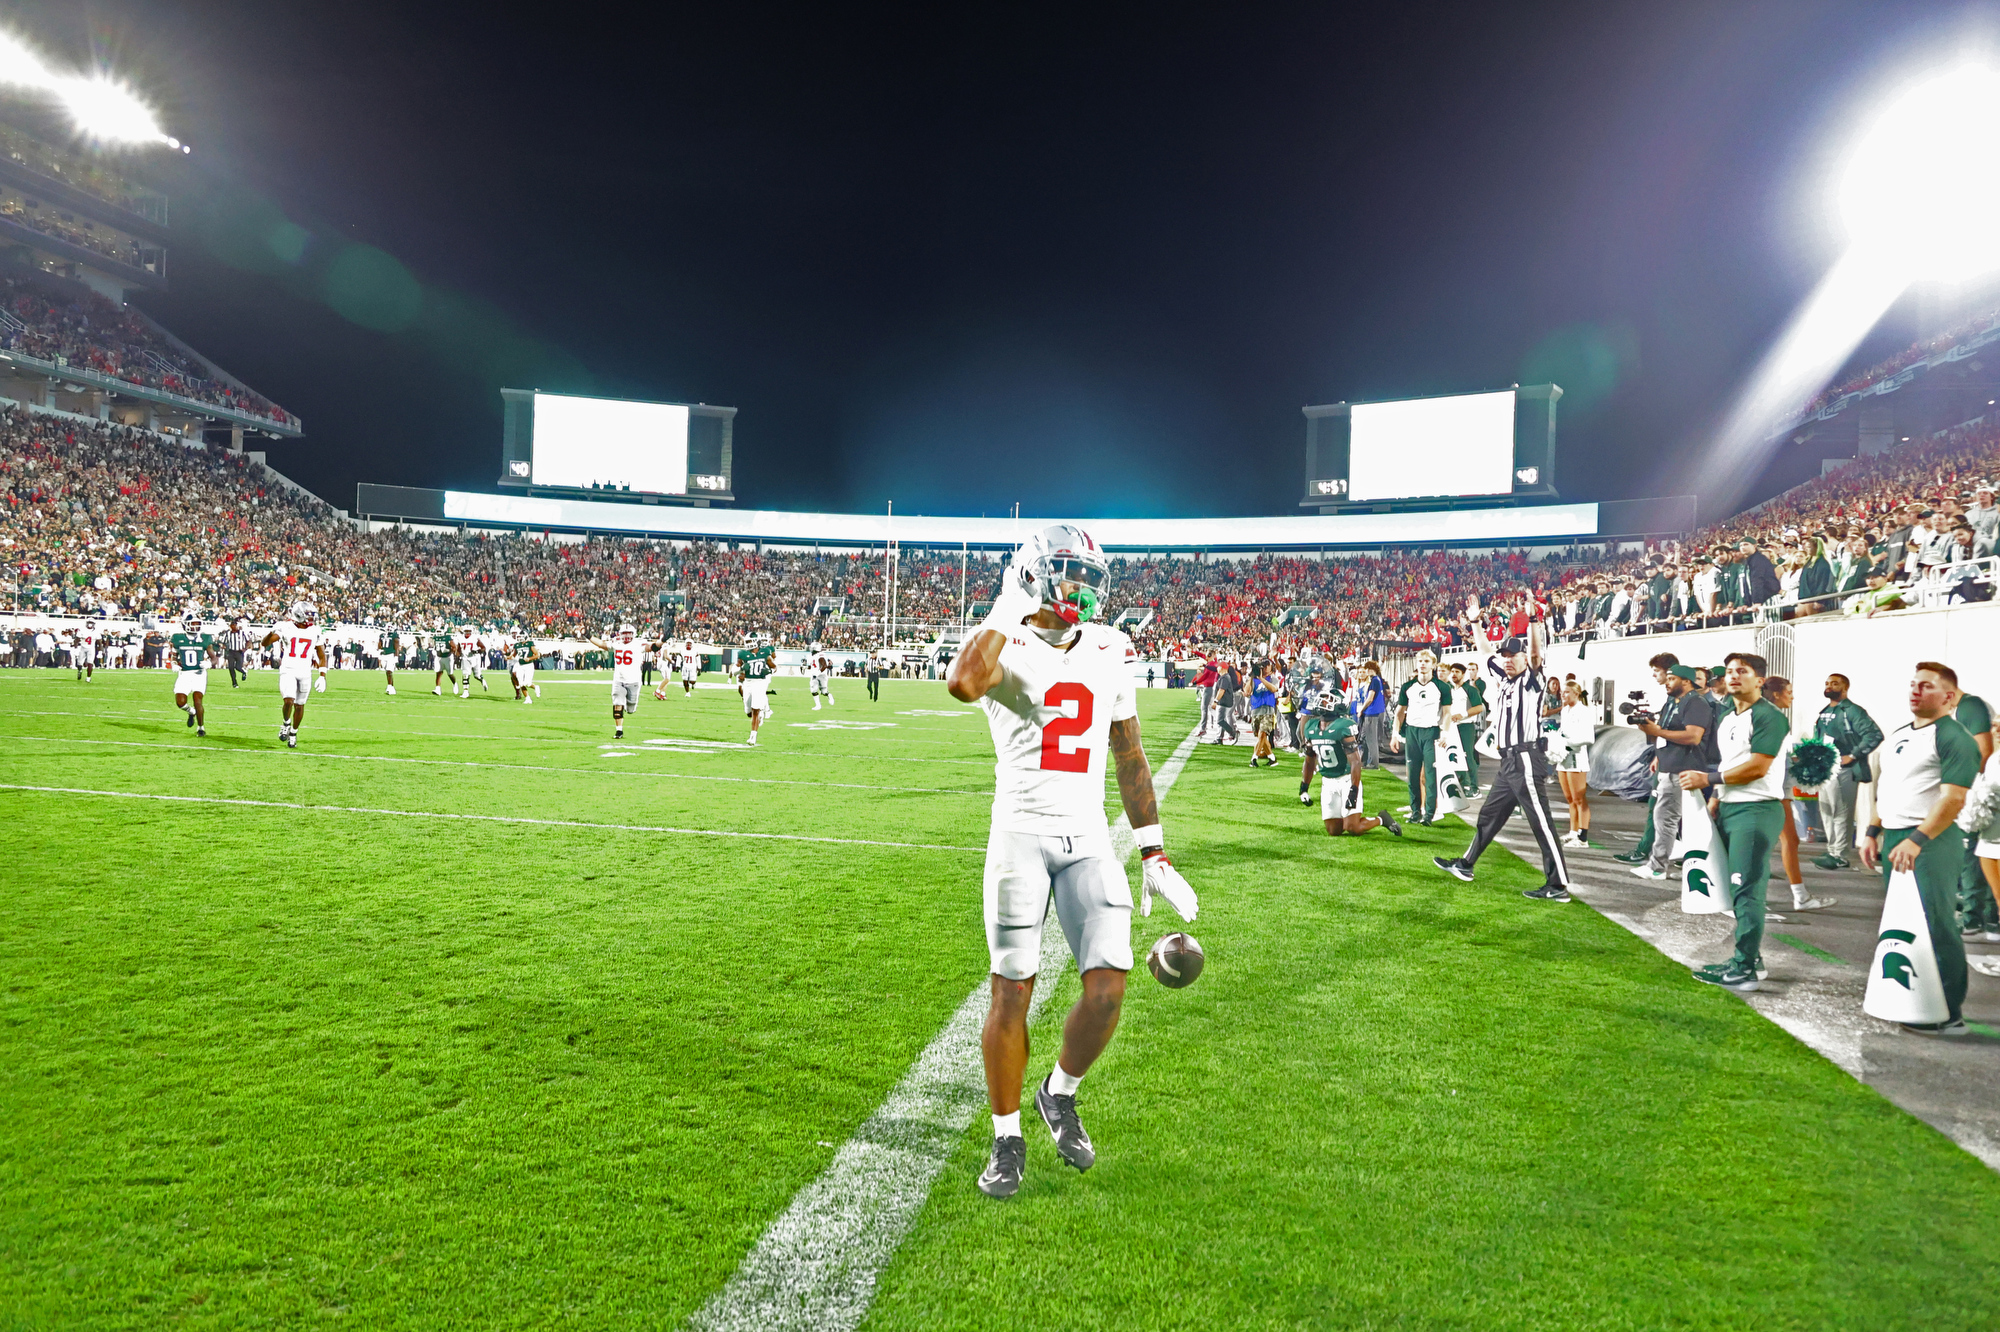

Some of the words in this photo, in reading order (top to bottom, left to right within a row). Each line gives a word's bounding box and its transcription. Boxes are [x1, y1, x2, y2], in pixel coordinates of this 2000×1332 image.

[512, 462, 529, 477] 40
[1318, 479, 1347, 495] 4:57
[85, 636, 92, 645] 4
[289, 637, 312, 658] 17
[461, 642, 474, 650] 77
[185, 650, 198, 666] 0
[615, 650, 633, 665] 56
[684, 656, 693, 664] 71
[749, 662, 764, 676] 10
[1040, 681, 1094, 773] 2
[1312, 745, 1339, 768] 19
